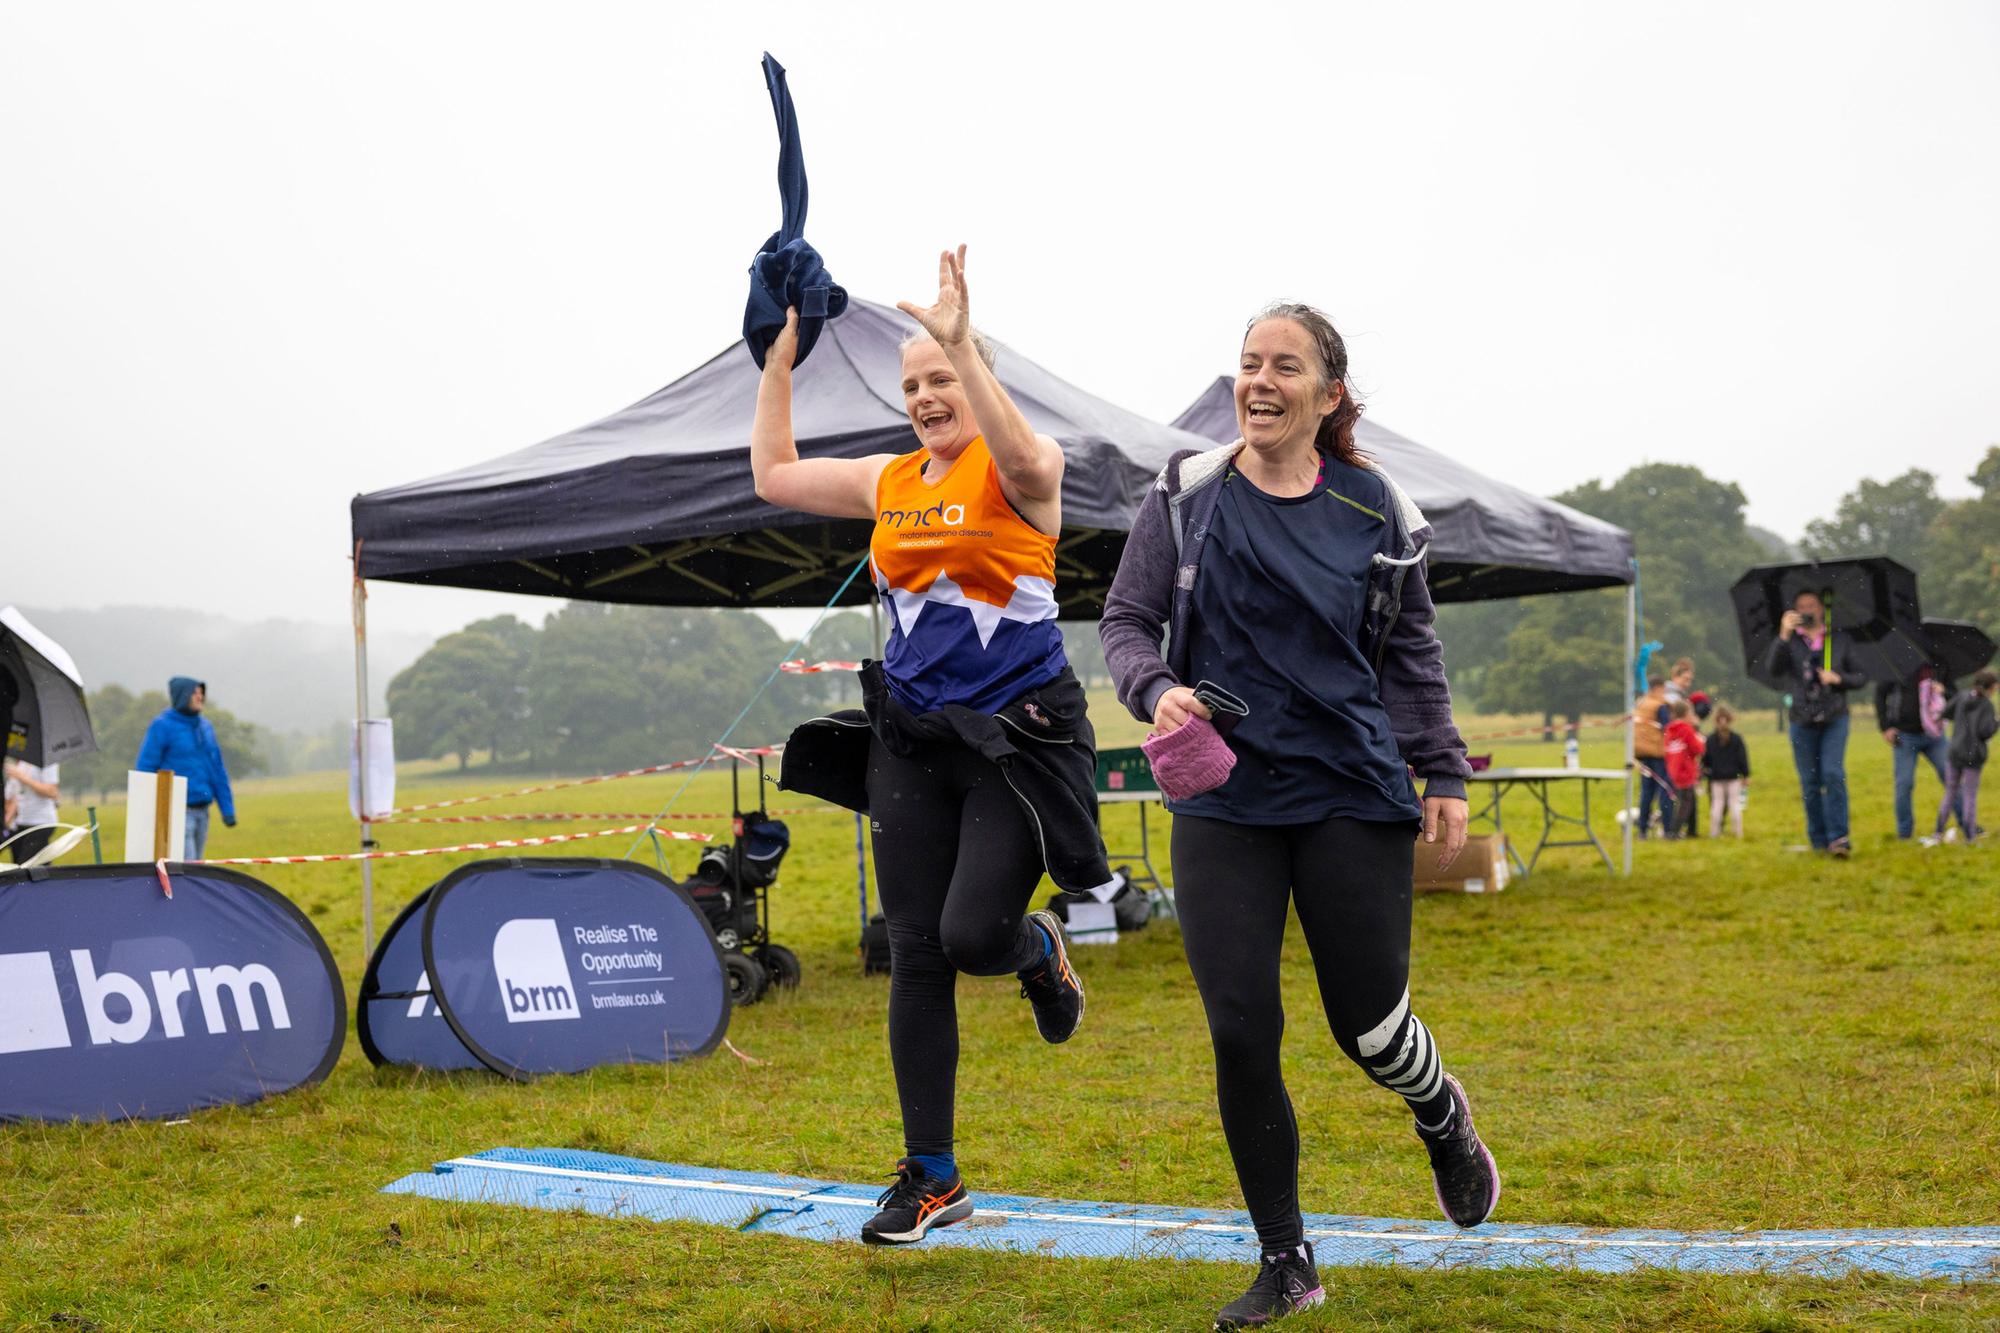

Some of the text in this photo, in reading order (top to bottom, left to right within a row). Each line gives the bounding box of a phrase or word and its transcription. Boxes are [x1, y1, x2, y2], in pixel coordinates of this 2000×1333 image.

[880, 500, 965, 528] mnda
[897, 539, 944, 548] association
[958, 528, 994, 538] disease
[573, 924, 658, 945] Realise The
[581, 949, 662, 974] Opportunity
[70, 949, 292, 1045] brm
[505, 979, 572, 1014] brm
[591, 990, 666, 1009] brmlaw.co.uk
